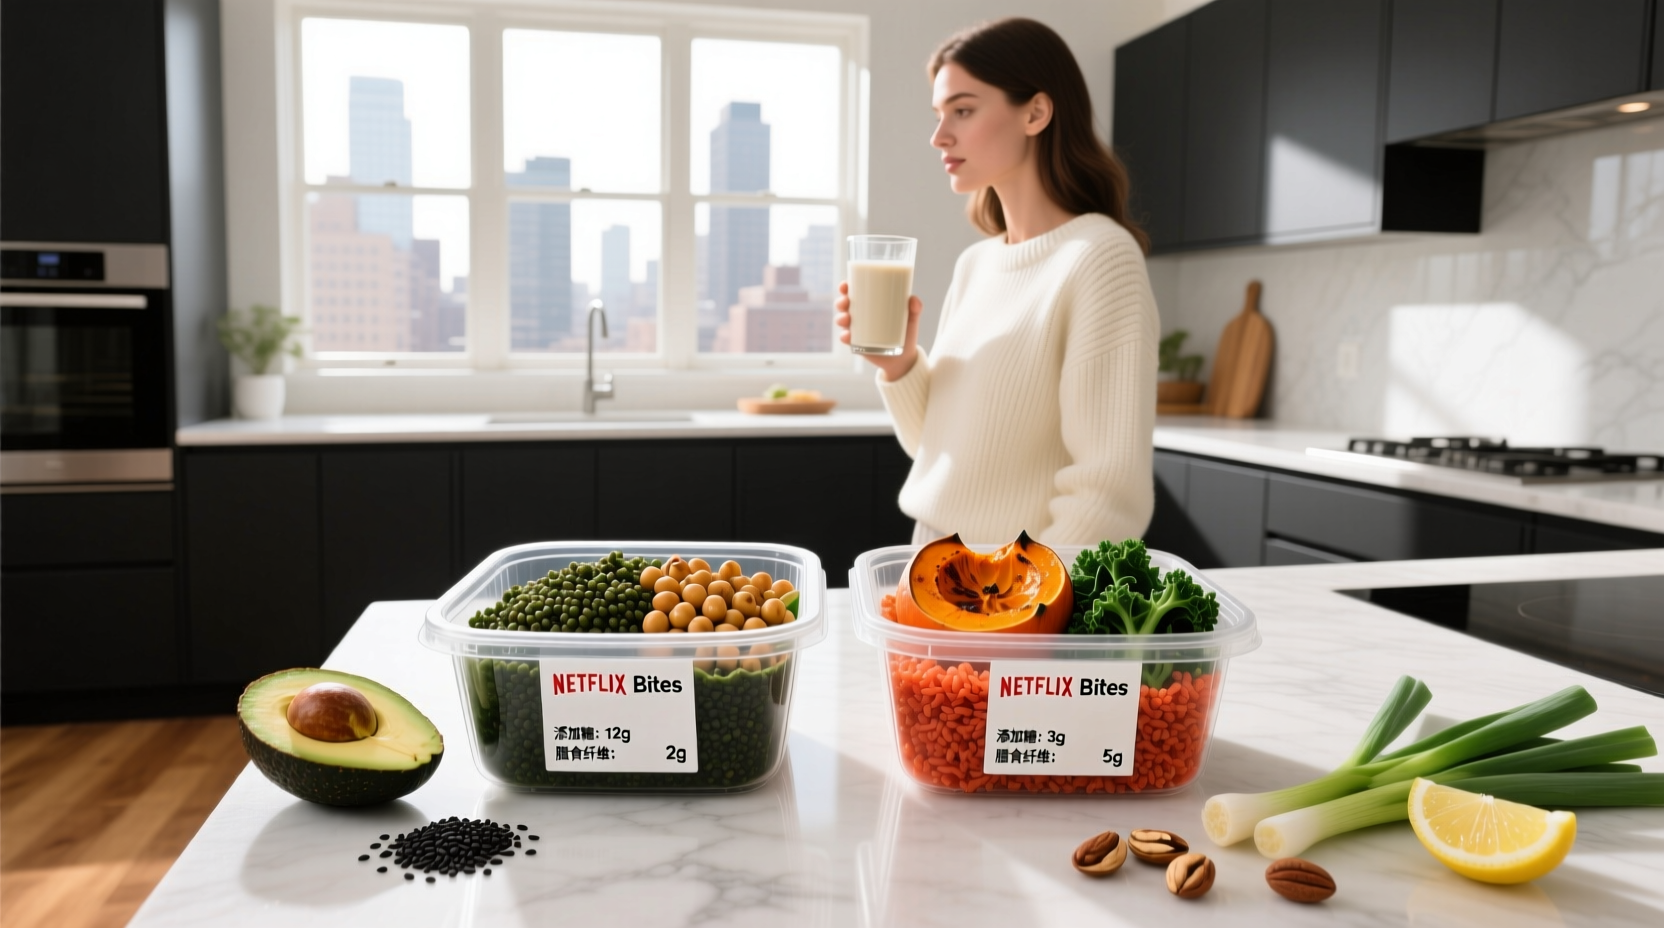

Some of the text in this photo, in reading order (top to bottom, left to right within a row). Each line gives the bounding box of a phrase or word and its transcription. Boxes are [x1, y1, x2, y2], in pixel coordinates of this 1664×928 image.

[553, 673, 683, 696] NETFLIX Bites
[999, 676, 1129, 698] NETFLIX Bites
[604, 727, 631, 744] 12g
[1047, 730, 1066, 747] 3g
[666, 745, 687, 764] 2g
[1102, 749, 1123, 768] 5g
